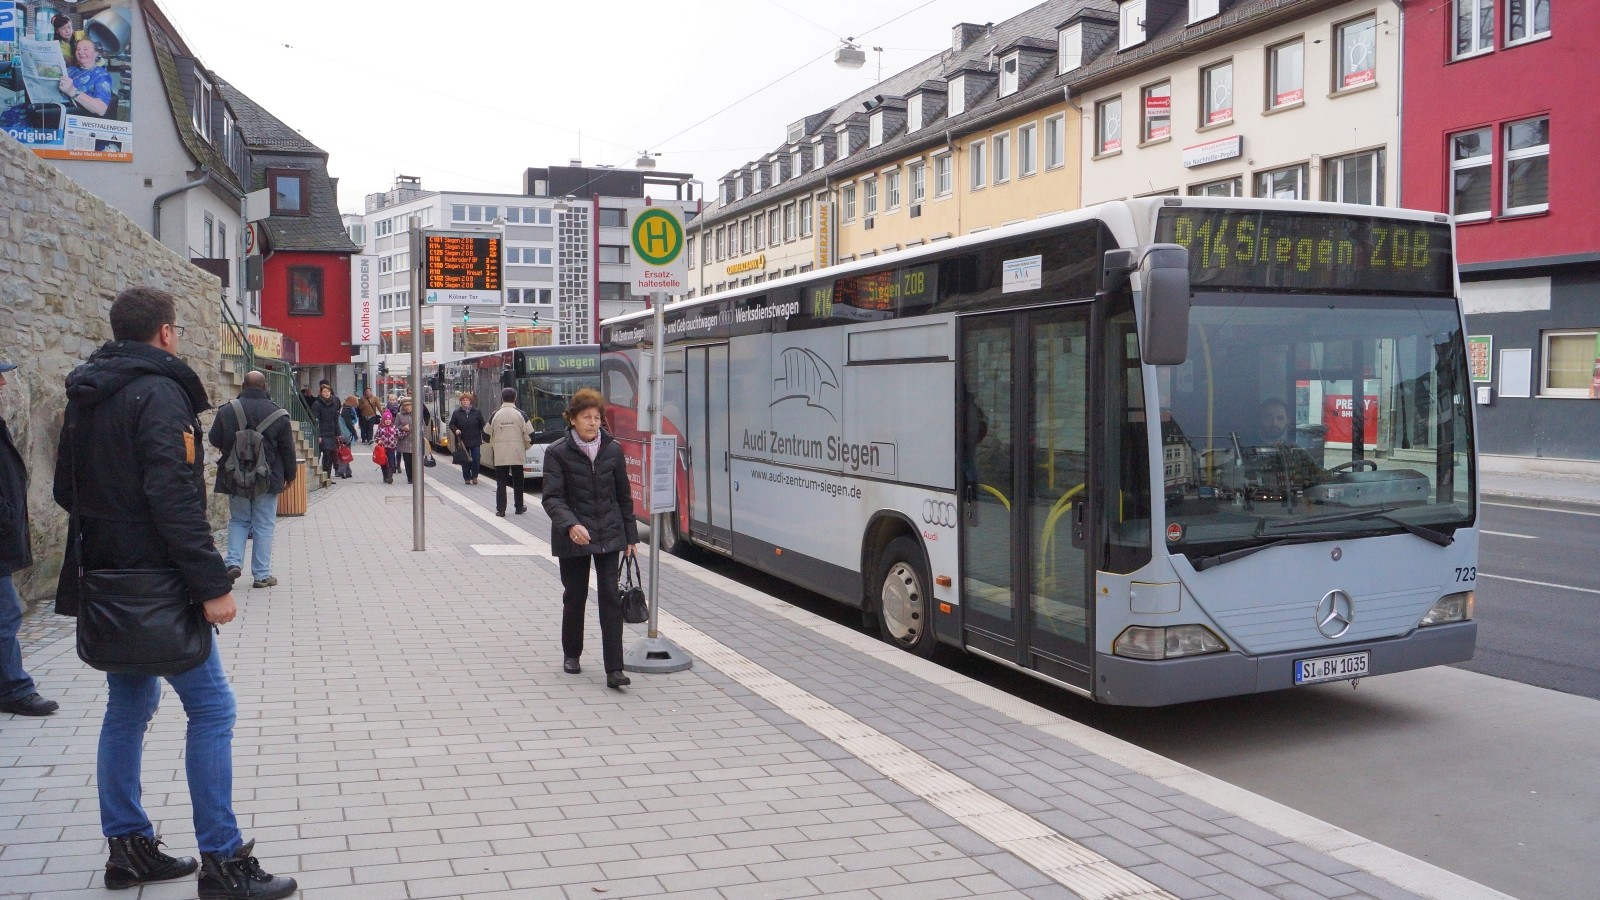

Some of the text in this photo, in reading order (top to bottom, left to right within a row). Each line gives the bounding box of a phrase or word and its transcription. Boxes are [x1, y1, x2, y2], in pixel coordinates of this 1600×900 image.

[9, 129, 60, 143] Original.
[82, 121, 128, 132] WESTFALENPOST
[647, 222, 668, 252] H
[1236, 220, 1352, 271] Siegen
[1371, 227, 1430, 267] ZOB
[644, 270, 673, 278] Ersatz-
[905, 271, 924, 295] ZOB
[360, 259, 370, 341] Kohlhas MODEN
[667, 319, 676, 334] und
[676, 315, 718, 332] Gebrauchtwagen
[735, 301, 799, 324] Werksdienstwagen
[529, 356, 595, 371] C101 Siegen
[1335, 399, 1370, 410] PREY
[743, 428, 879, 471] Audi Zentrum Siegen
[751, 469, 862, 499] www.audi-zentrum-siegen.de
[923, 530, 938, 541] Audi
[1455, 566, 1476, 583] 723
[1303, 656, 1366, 678] SI BW 1035
